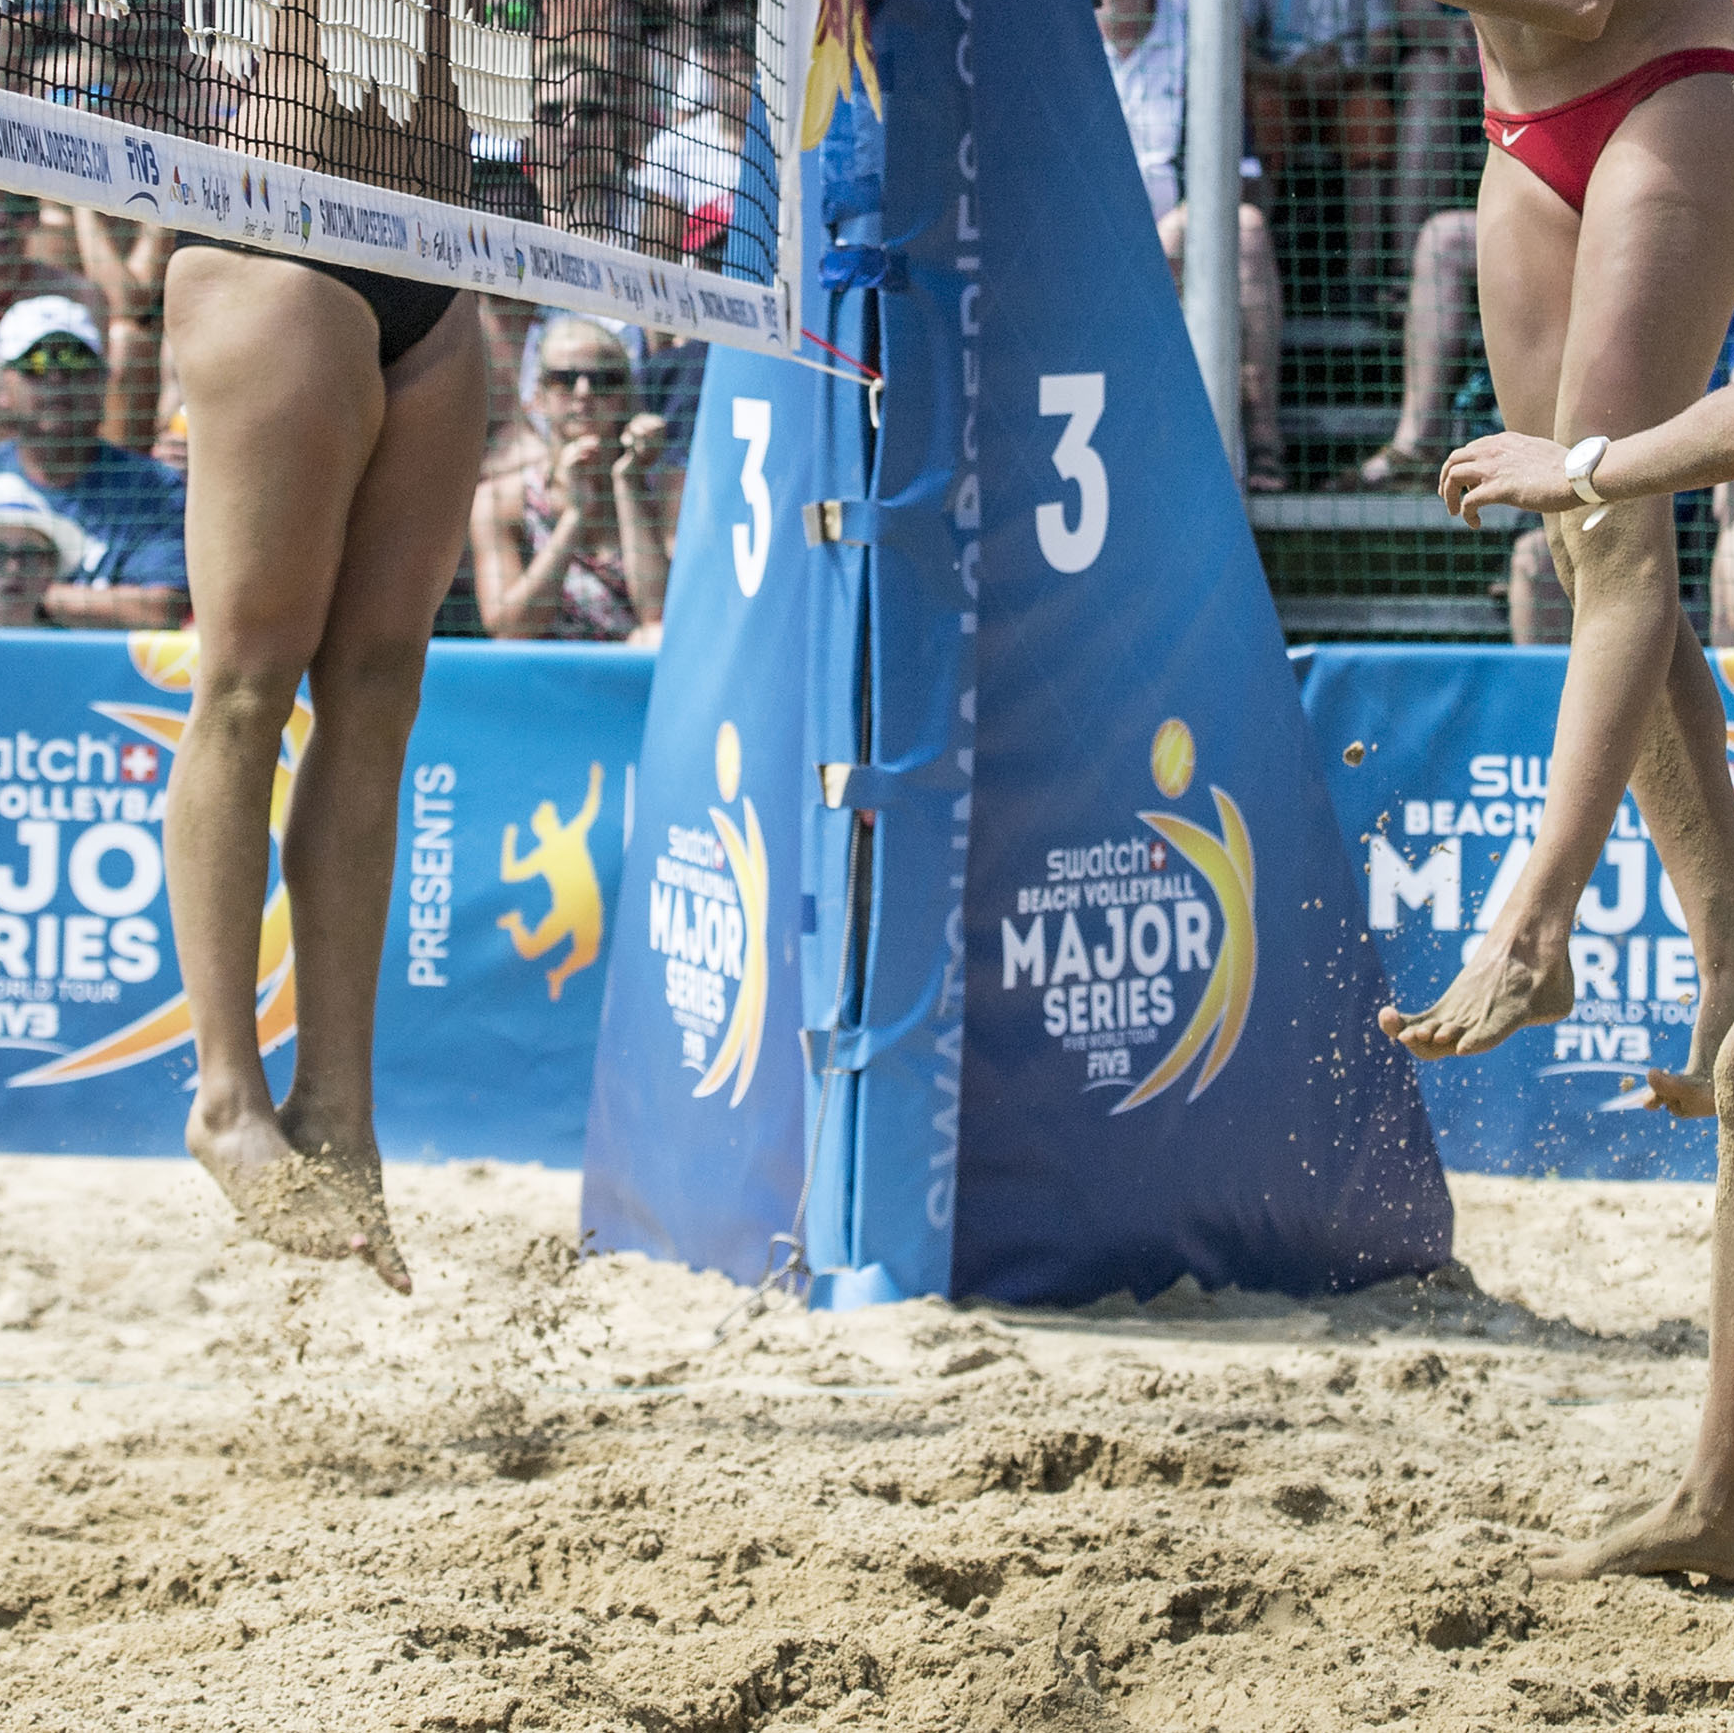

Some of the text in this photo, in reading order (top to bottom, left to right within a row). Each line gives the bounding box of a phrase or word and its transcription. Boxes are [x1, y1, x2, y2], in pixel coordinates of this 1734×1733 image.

[730, 395, 774, 601] 3
[1034, 371, 1111, 575] 3
[407, 762, 457, 988] PRESENTS
[1046, 837, 1150, 882] swatch
[1017, 873, 1196, 915] BEACH VOLLEYBALL
[649, 878, 744, 982] MAJOR
[1001, 899, 1212, 991] MAJOR
[57, 978, 122, 1004] TOUR
[665, 955, 727, 1025] SERIES
[1043, 976, 1176, 1038] SERIES
[1652, 1002, 1698, 1025] TOU
[1087, 1047, 1132, 1079] FIVB
[1553, 1025, 1652, 1061] FIVB
